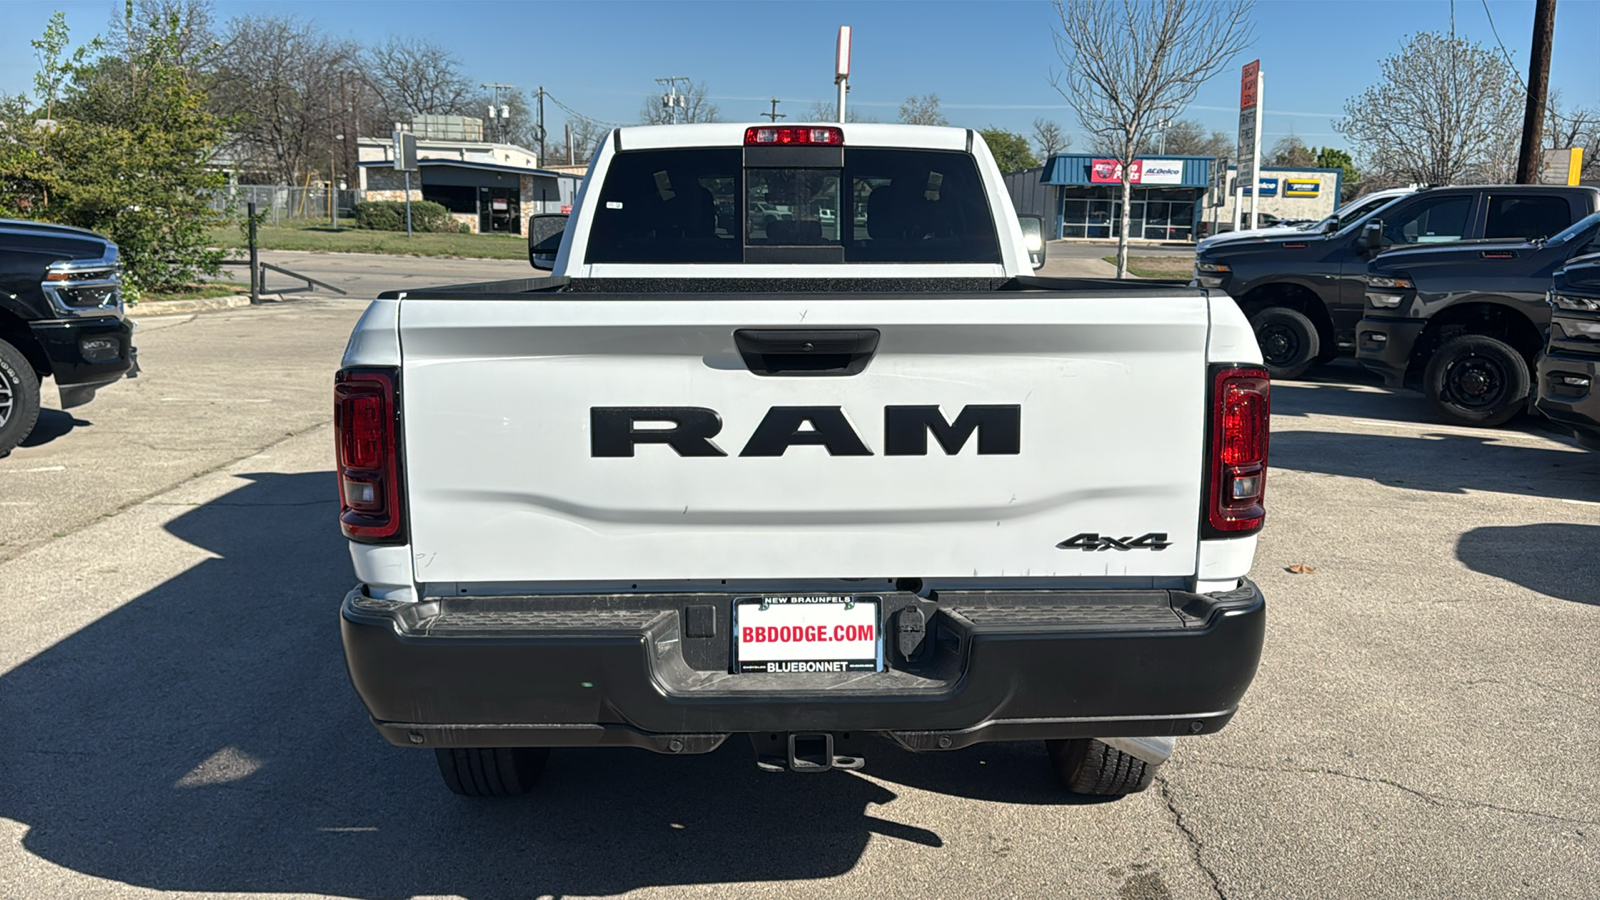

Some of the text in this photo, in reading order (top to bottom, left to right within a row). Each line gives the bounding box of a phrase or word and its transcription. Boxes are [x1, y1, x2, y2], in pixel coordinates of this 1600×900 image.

[591, 404, 1021, 458] RAM
[1055, 532, 1174, 552] 4x4
[791, 596, 851, 604] BRAUNFELS
[743, 625, 873, 642] BBDODGE.COM
[767, 661, 848, 673] BLUEBONNET
